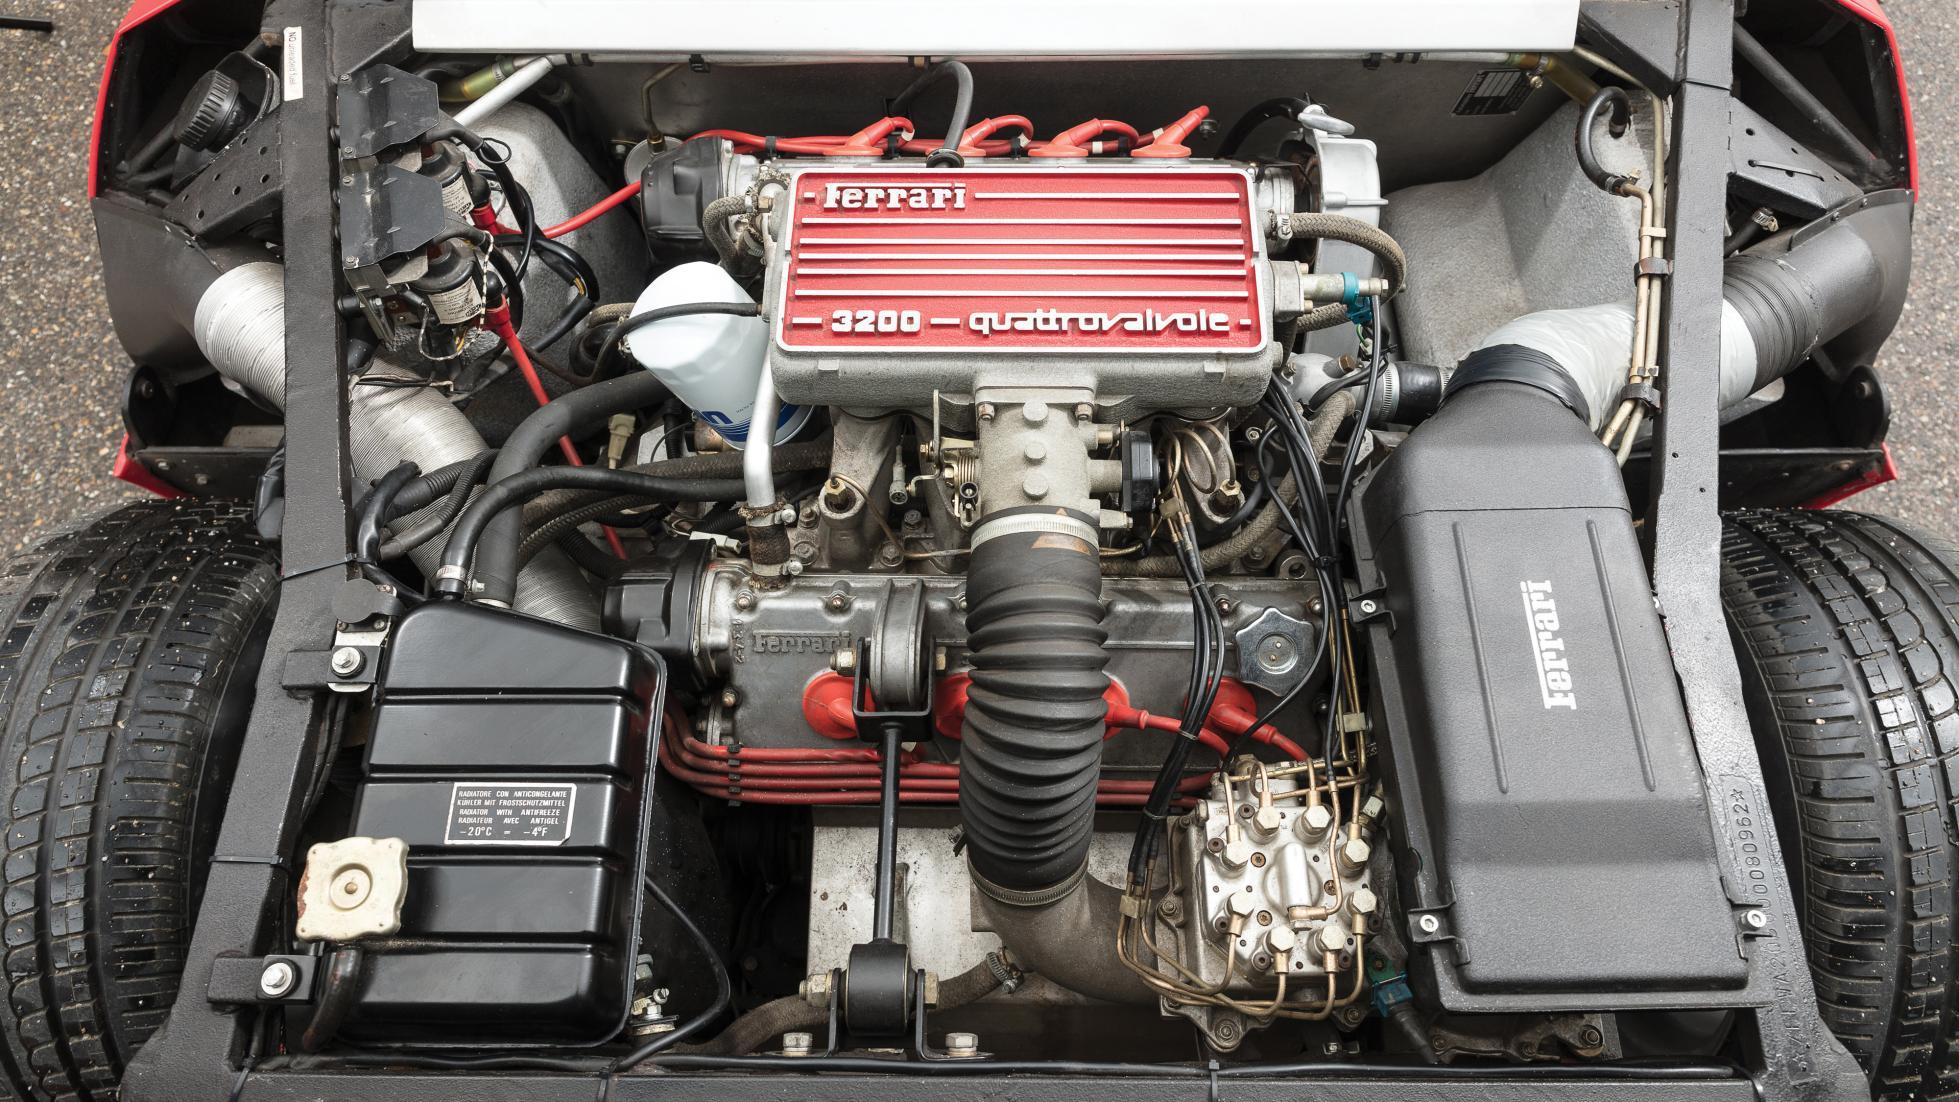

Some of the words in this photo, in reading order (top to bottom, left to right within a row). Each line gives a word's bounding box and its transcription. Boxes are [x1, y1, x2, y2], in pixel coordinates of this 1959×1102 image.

[288, 31, 297, 42] NO
[823, 182, 966, 210] Ferrari
[831, 309, 921, 332] 3200
[968, 308, 1229, 336] quattrovalvole
[752, 630, 850, 653] Ferrari
[1519, 579, 1577, 710] Ferrari
[456, 798, 482, 806] KÜHLER
[498, 799, 566, 807] FROSTSCHUTZMITTEL
[458, 790, 492, 798] RADIATORE
[496, 790, 510, 798] CON
[513, 790, 567, 798] ANTICONGELANTE
[530, 817, 559, 825] ANTIGEL
